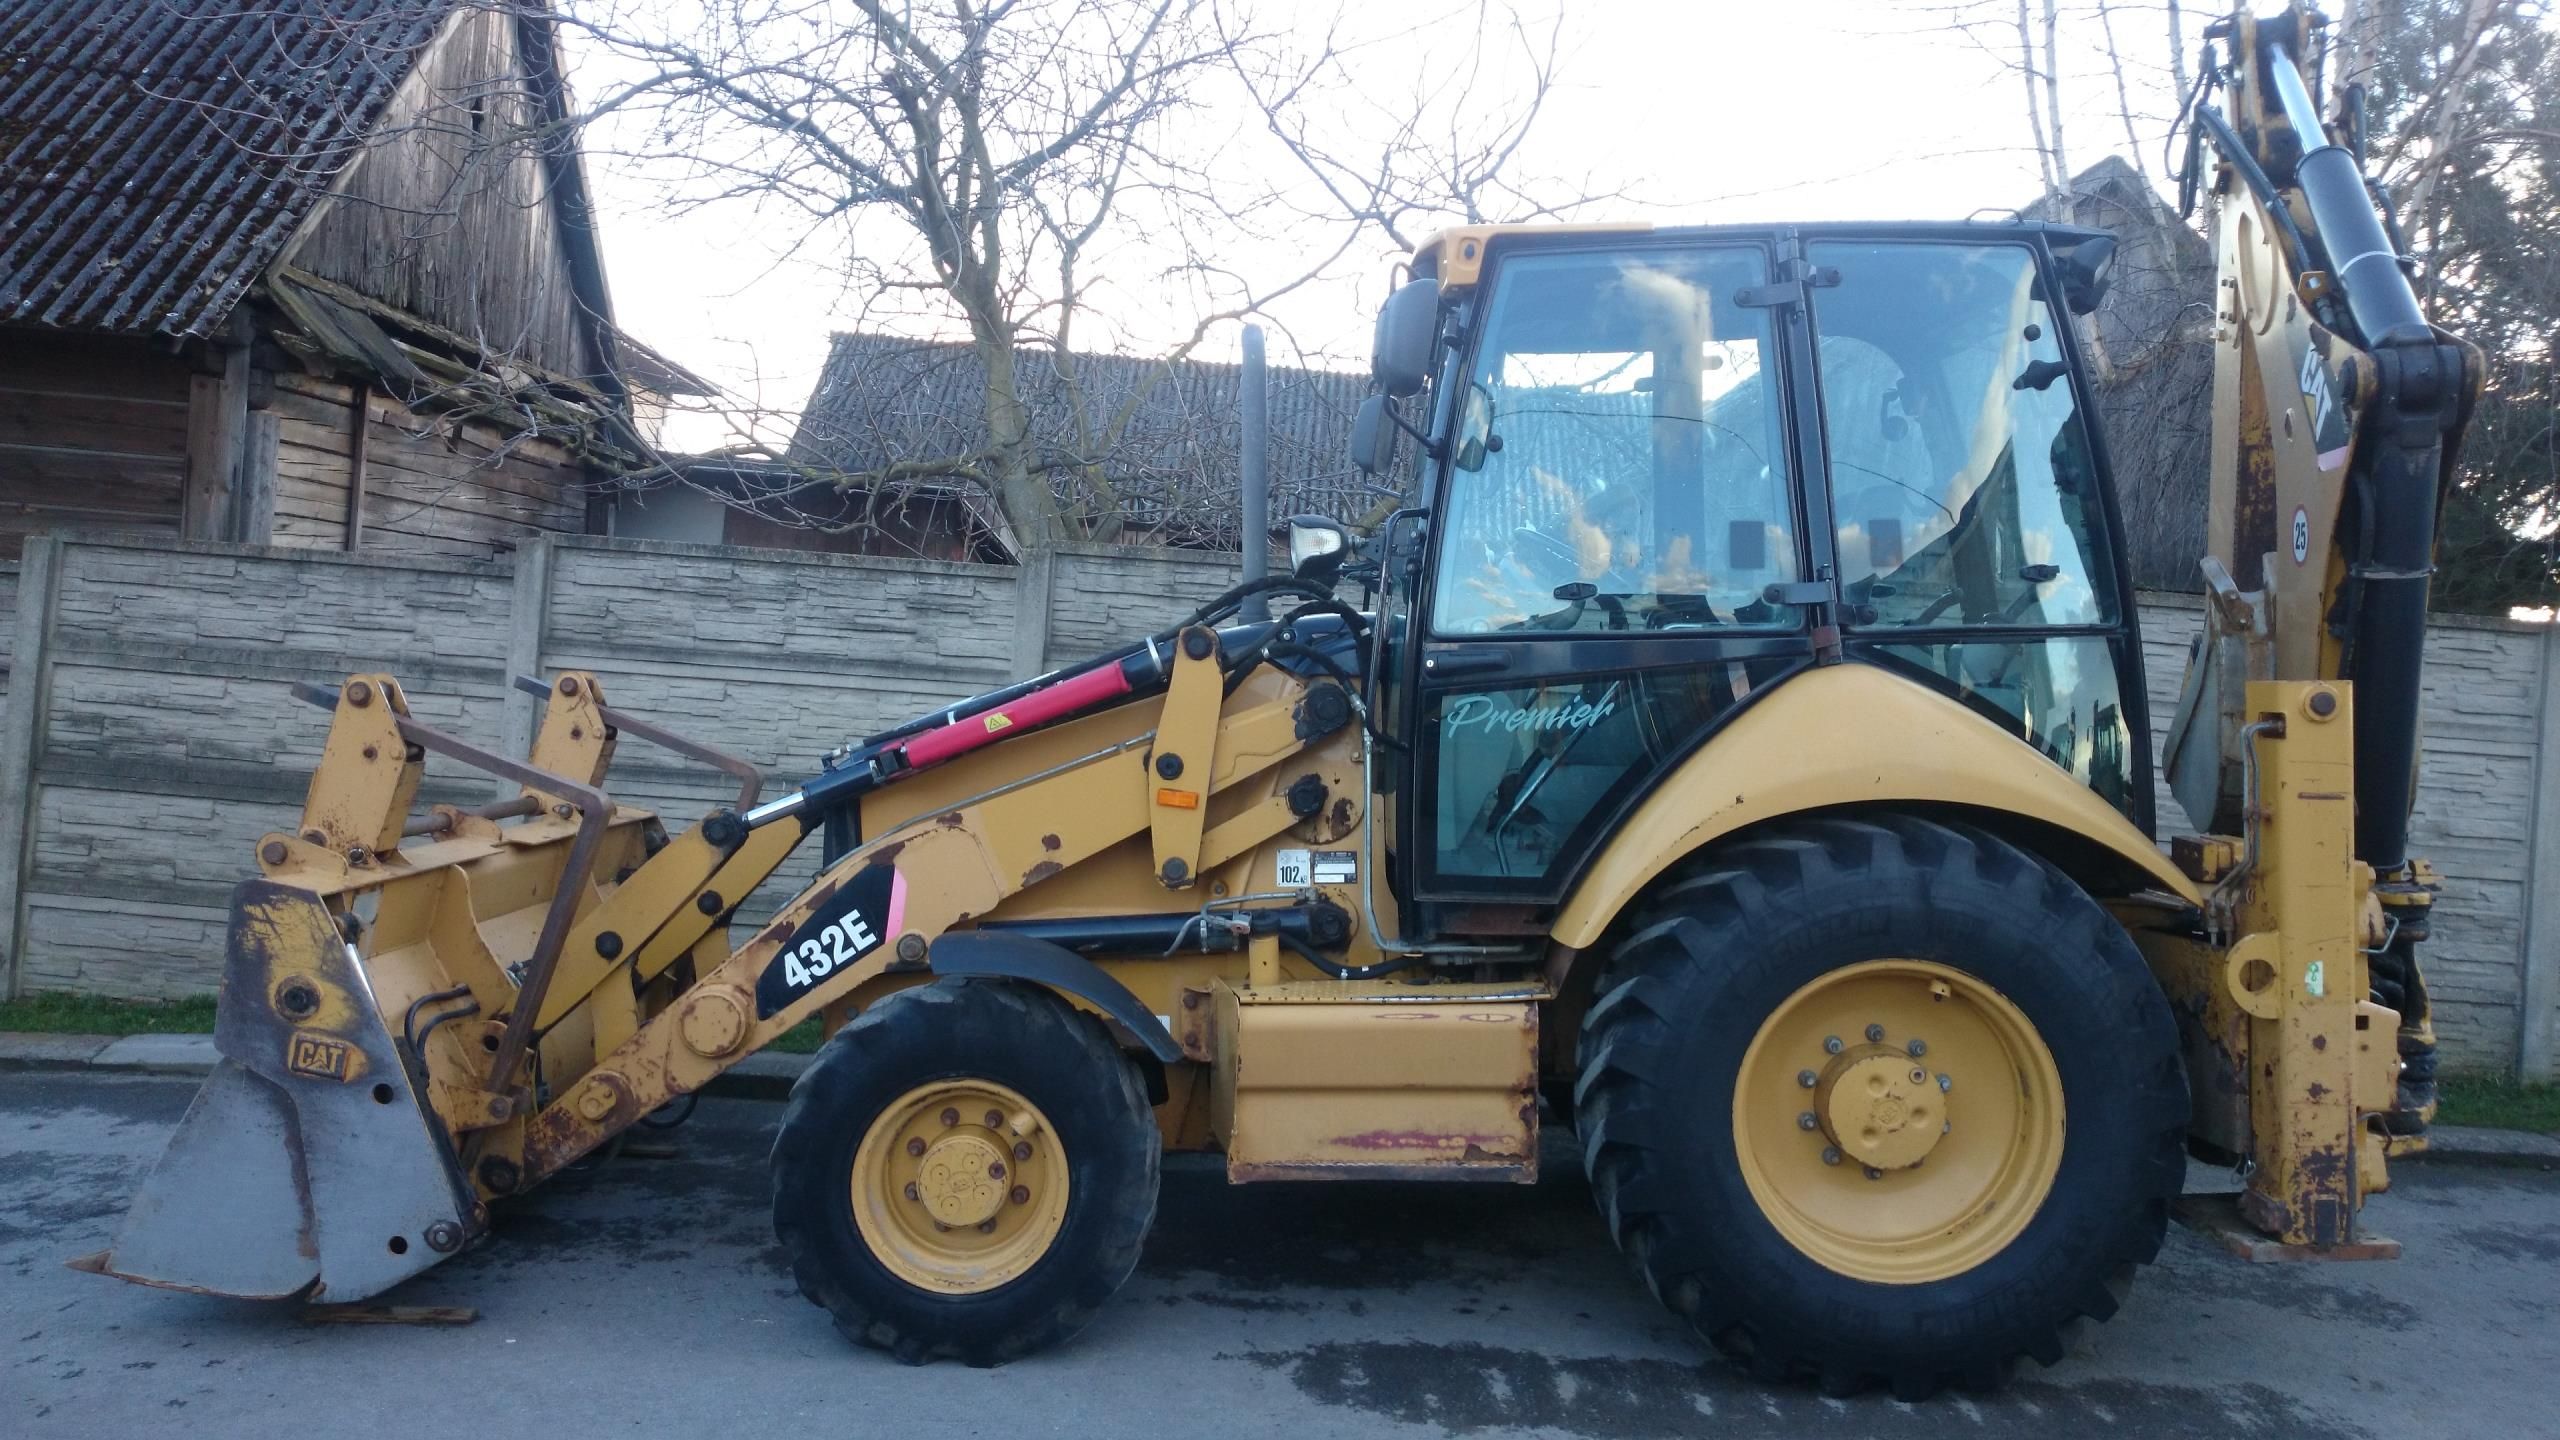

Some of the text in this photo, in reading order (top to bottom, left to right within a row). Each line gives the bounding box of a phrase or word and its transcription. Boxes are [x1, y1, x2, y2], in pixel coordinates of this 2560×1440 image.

[2301, 342, 2332, 442] CAT
[2295, 522, 2306, 550] 25
[1447, 692, 1616, 738] Premier
[1280, 866, 1299, 883] 102
[784, 909, 877, 987] 432E
[298, 1042, 342, 1073] CAT
